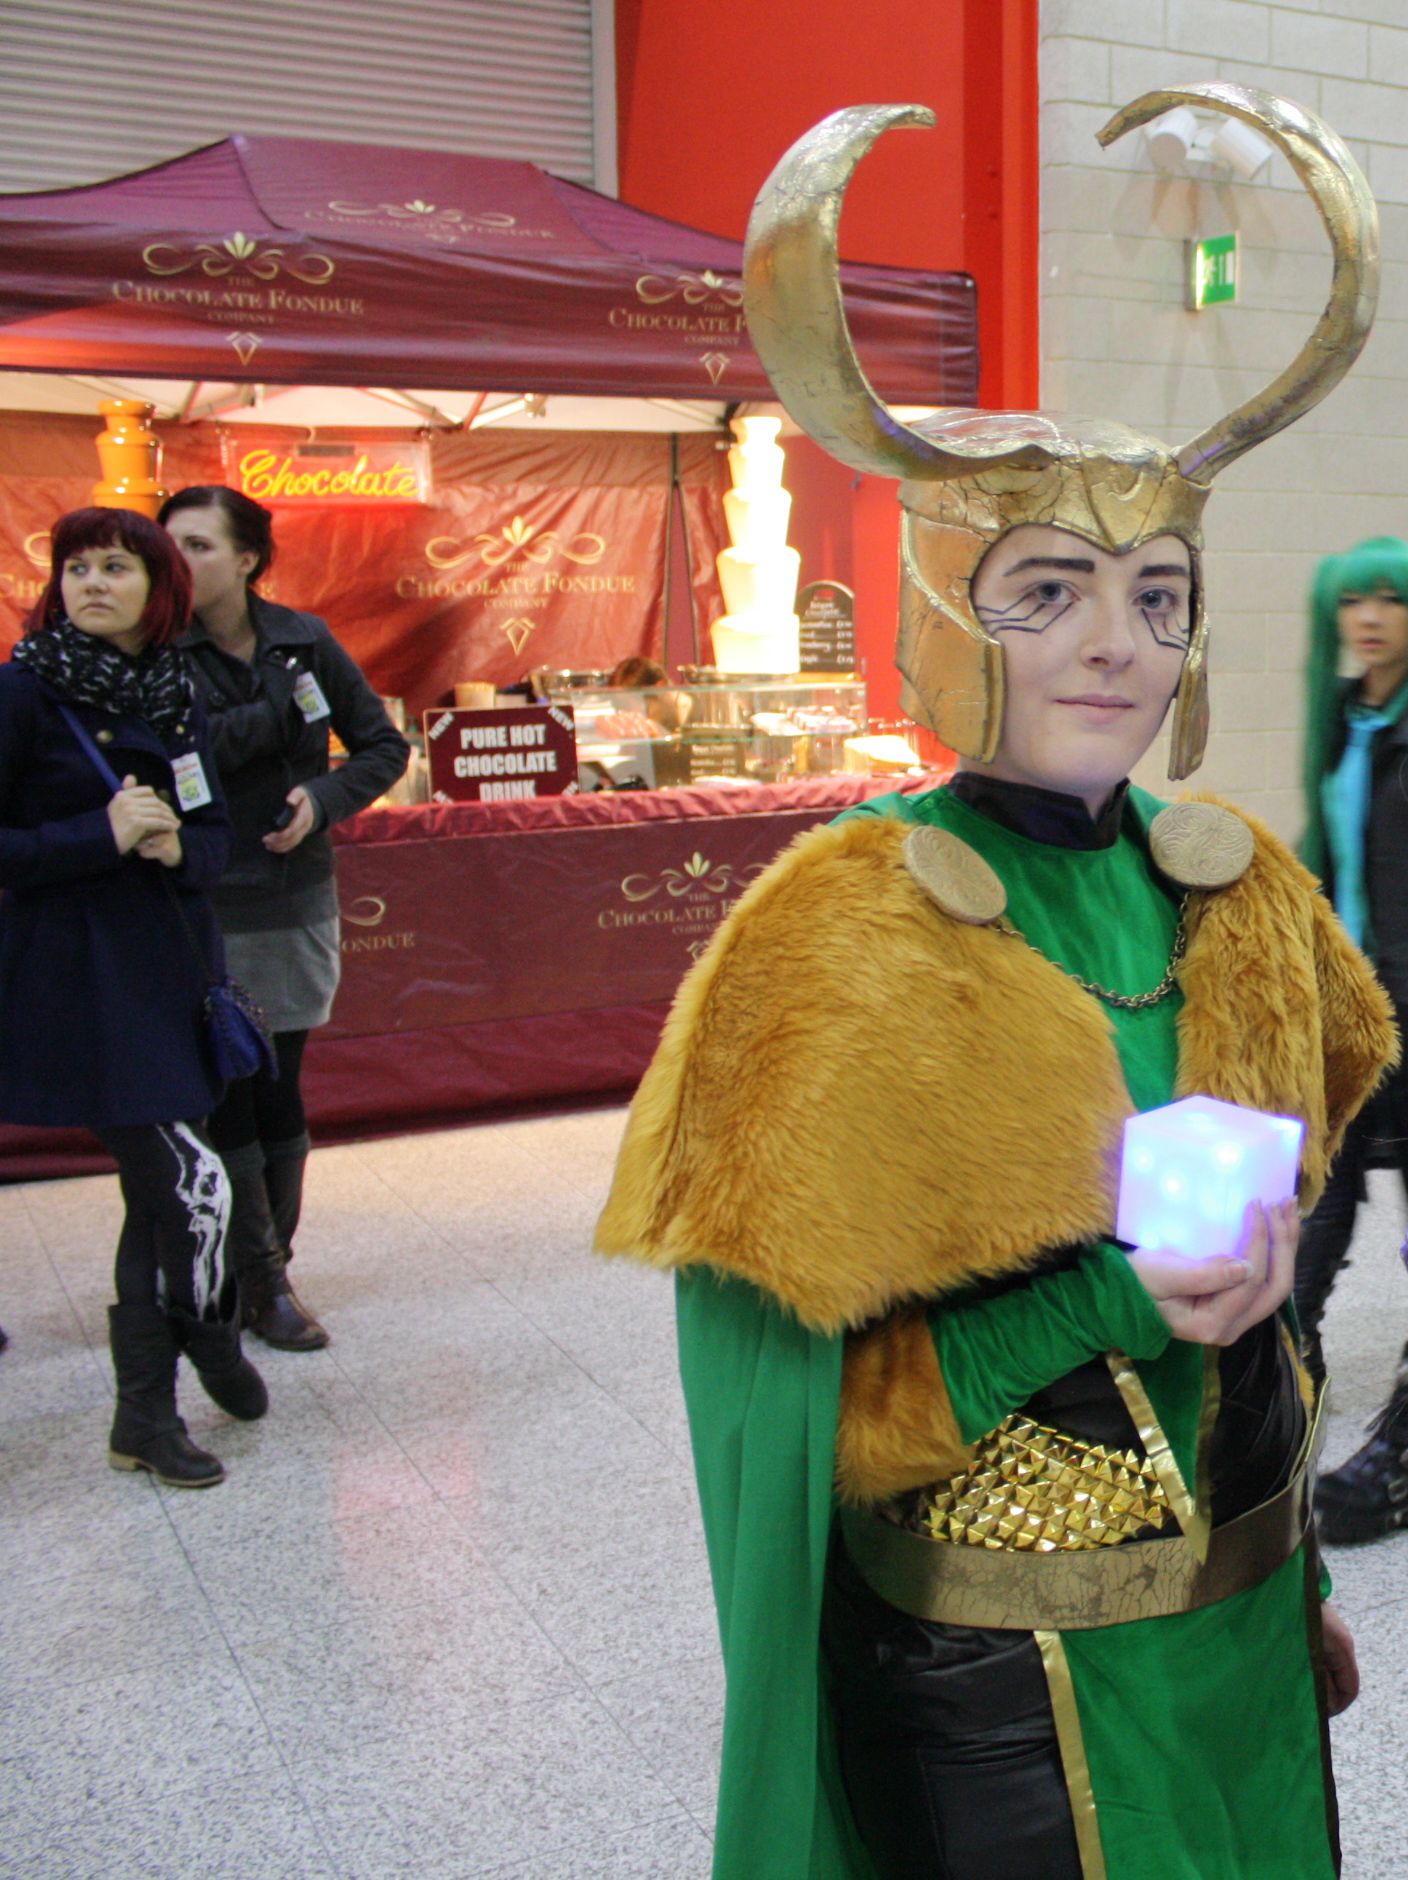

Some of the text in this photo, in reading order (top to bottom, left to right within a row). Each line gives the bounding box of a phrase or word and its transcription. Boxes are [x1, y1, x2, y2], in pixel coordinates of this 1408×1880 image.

[112, 280, 364, 316] CHOCOLATE FONDUE
[207, 310, 276, 325] COMPANY
[609, 307, 730, 332] CHOCOLATE
[239, 448, 419, 499] Chocolate
[396, 571, 636, 600] CHOCOLATE FONDUE
[428, 711, 455, 741] NEW
[547, 705, 575, 732] NEW
[460, 724, 547, 750] PURE HOT
[454, 751, 558, 779] CHOCOLATE
[479, 779, 537, 804] DRINK
[598, 904, 717, 930] CHOCOLATE
[341, 930, 416, 953] ONDUE
